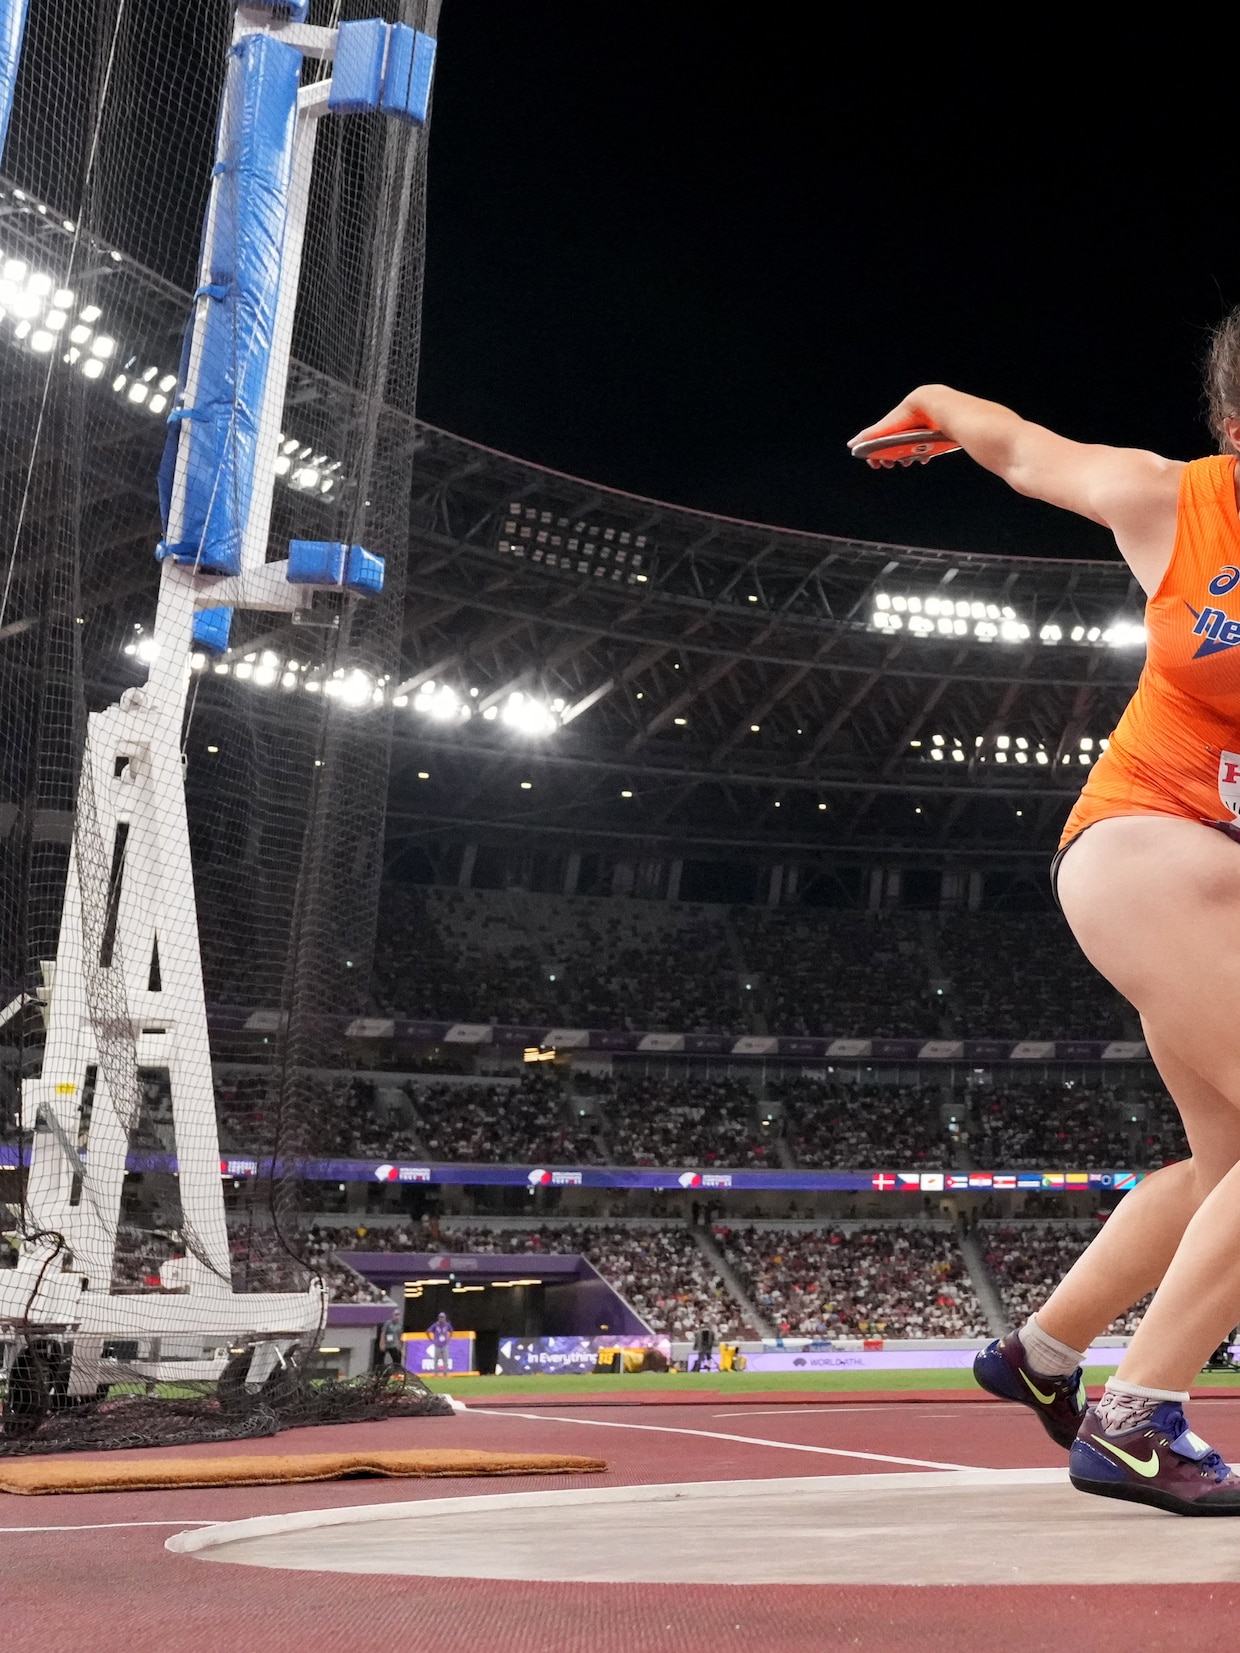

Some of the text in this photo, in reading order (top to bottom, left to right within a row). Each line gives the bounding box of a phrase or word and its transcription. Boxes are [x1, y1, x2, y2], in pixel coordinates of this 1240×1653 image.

[527, 1352, 538, 1363] In
[539, 1352, 598, 1365] Everything
[811, 1358, 840, 1366] WORLD
